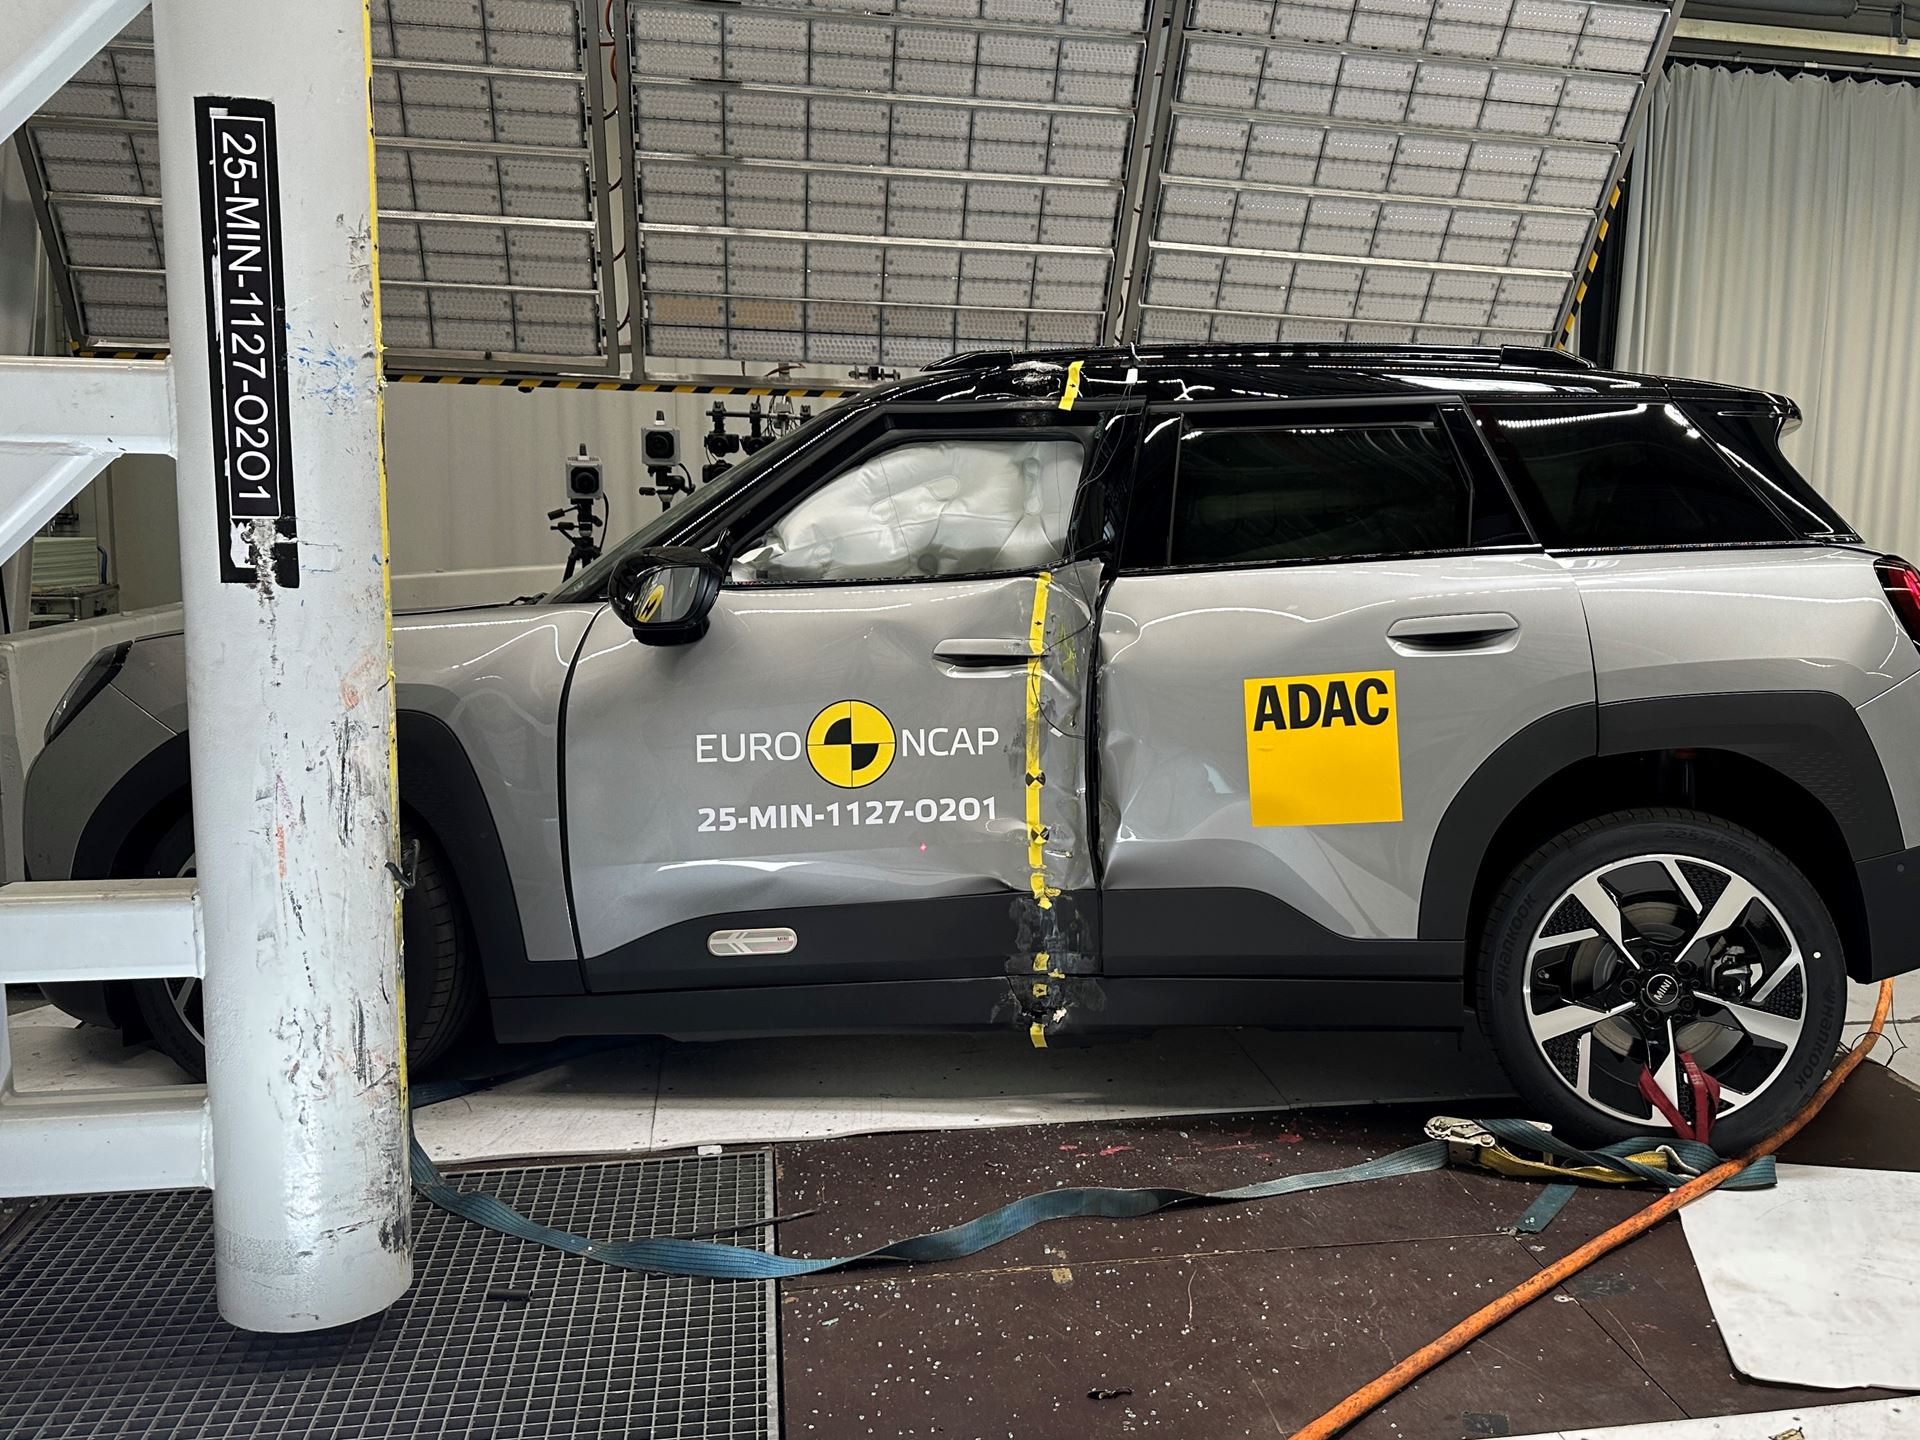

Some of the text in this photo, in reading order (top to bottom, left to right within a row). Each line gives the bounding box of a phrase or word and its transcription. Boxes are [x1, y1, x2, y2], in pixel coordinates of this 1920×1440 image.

[1253, 676, 1390, 731] ADAC
[696, 726, 1000, 763] EURO NCAP
[697, 796, 997, 832] 25-MIN-1127-0201
[1653, 978, 1672, 1001] MINI
